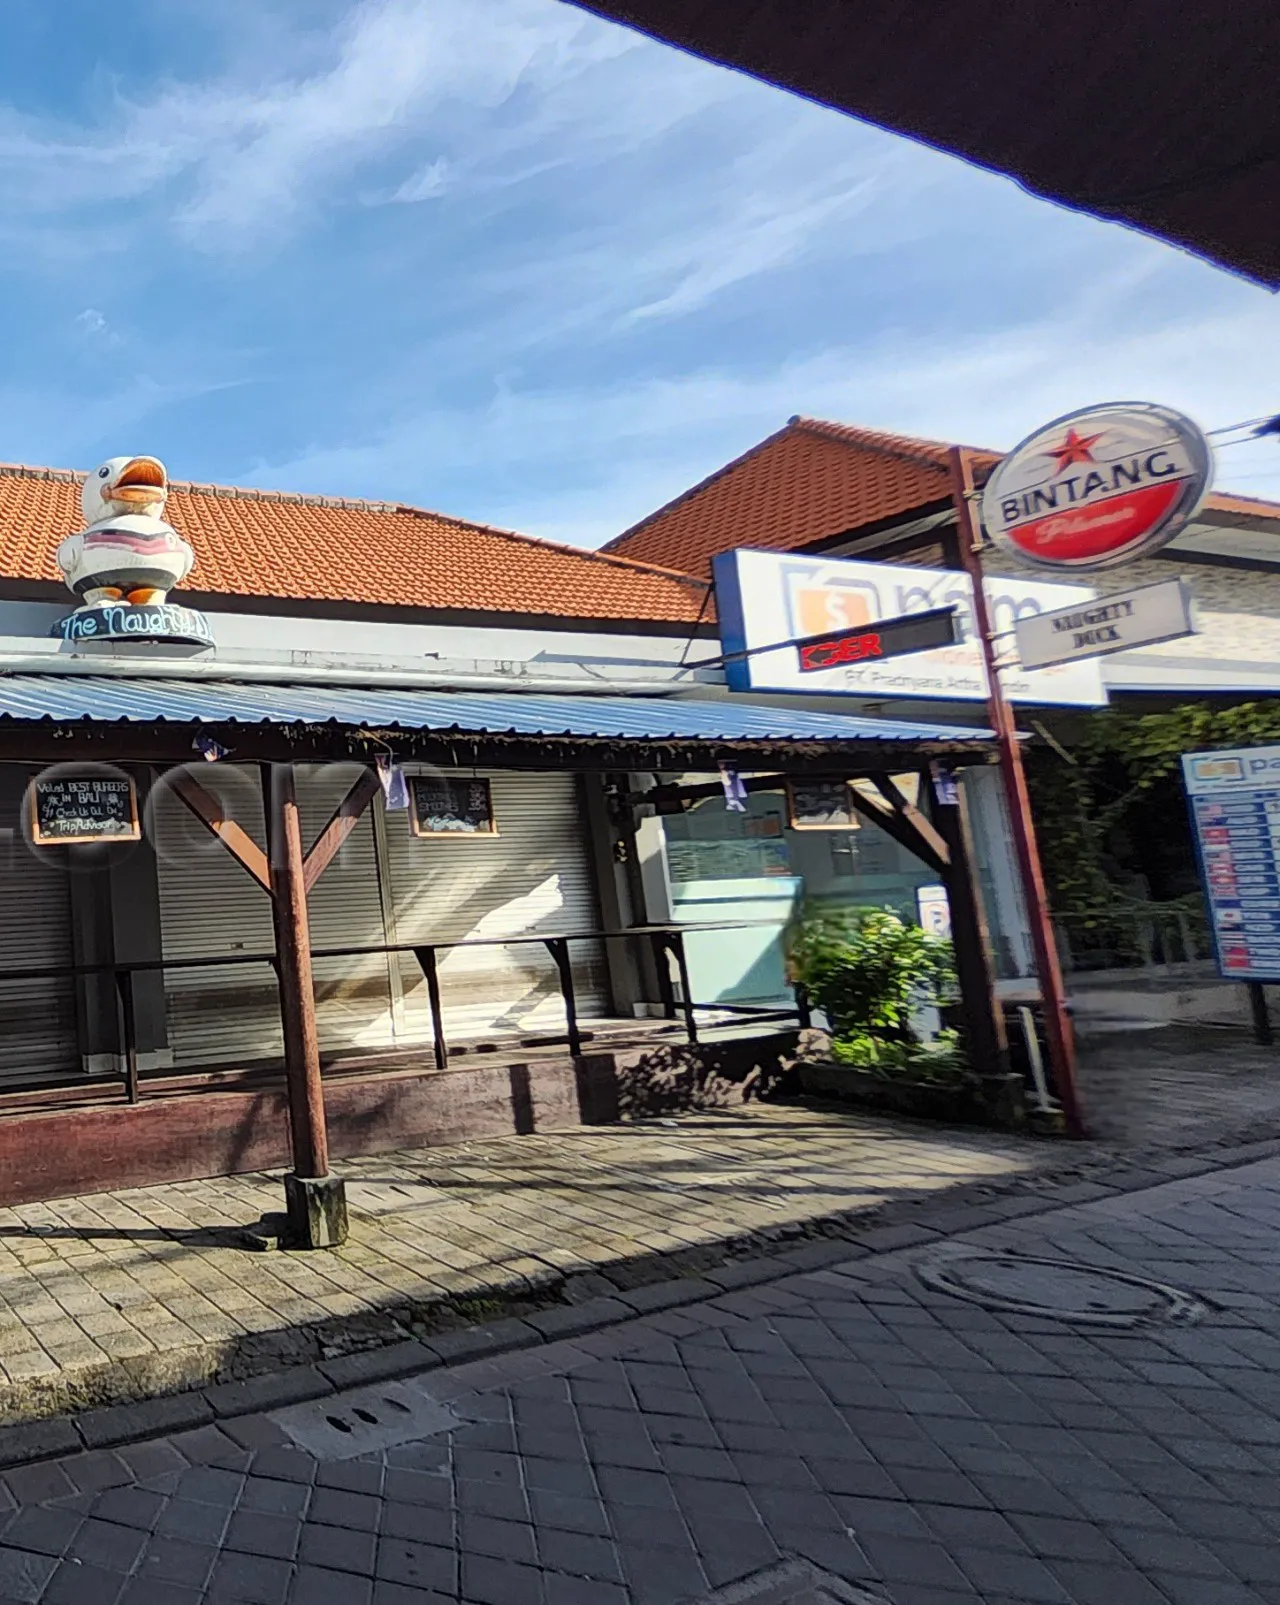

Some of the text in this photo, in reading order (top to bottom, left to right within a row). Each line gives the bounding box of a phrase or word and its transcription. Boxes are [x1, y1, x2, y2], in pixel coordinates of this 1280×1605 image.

[1001, 451, 1177, 522] BINTANG
[61, 612, 97, 639] The
[103, 605, 195, 635] Naughty
[68, 782, 90, 793] BEST
